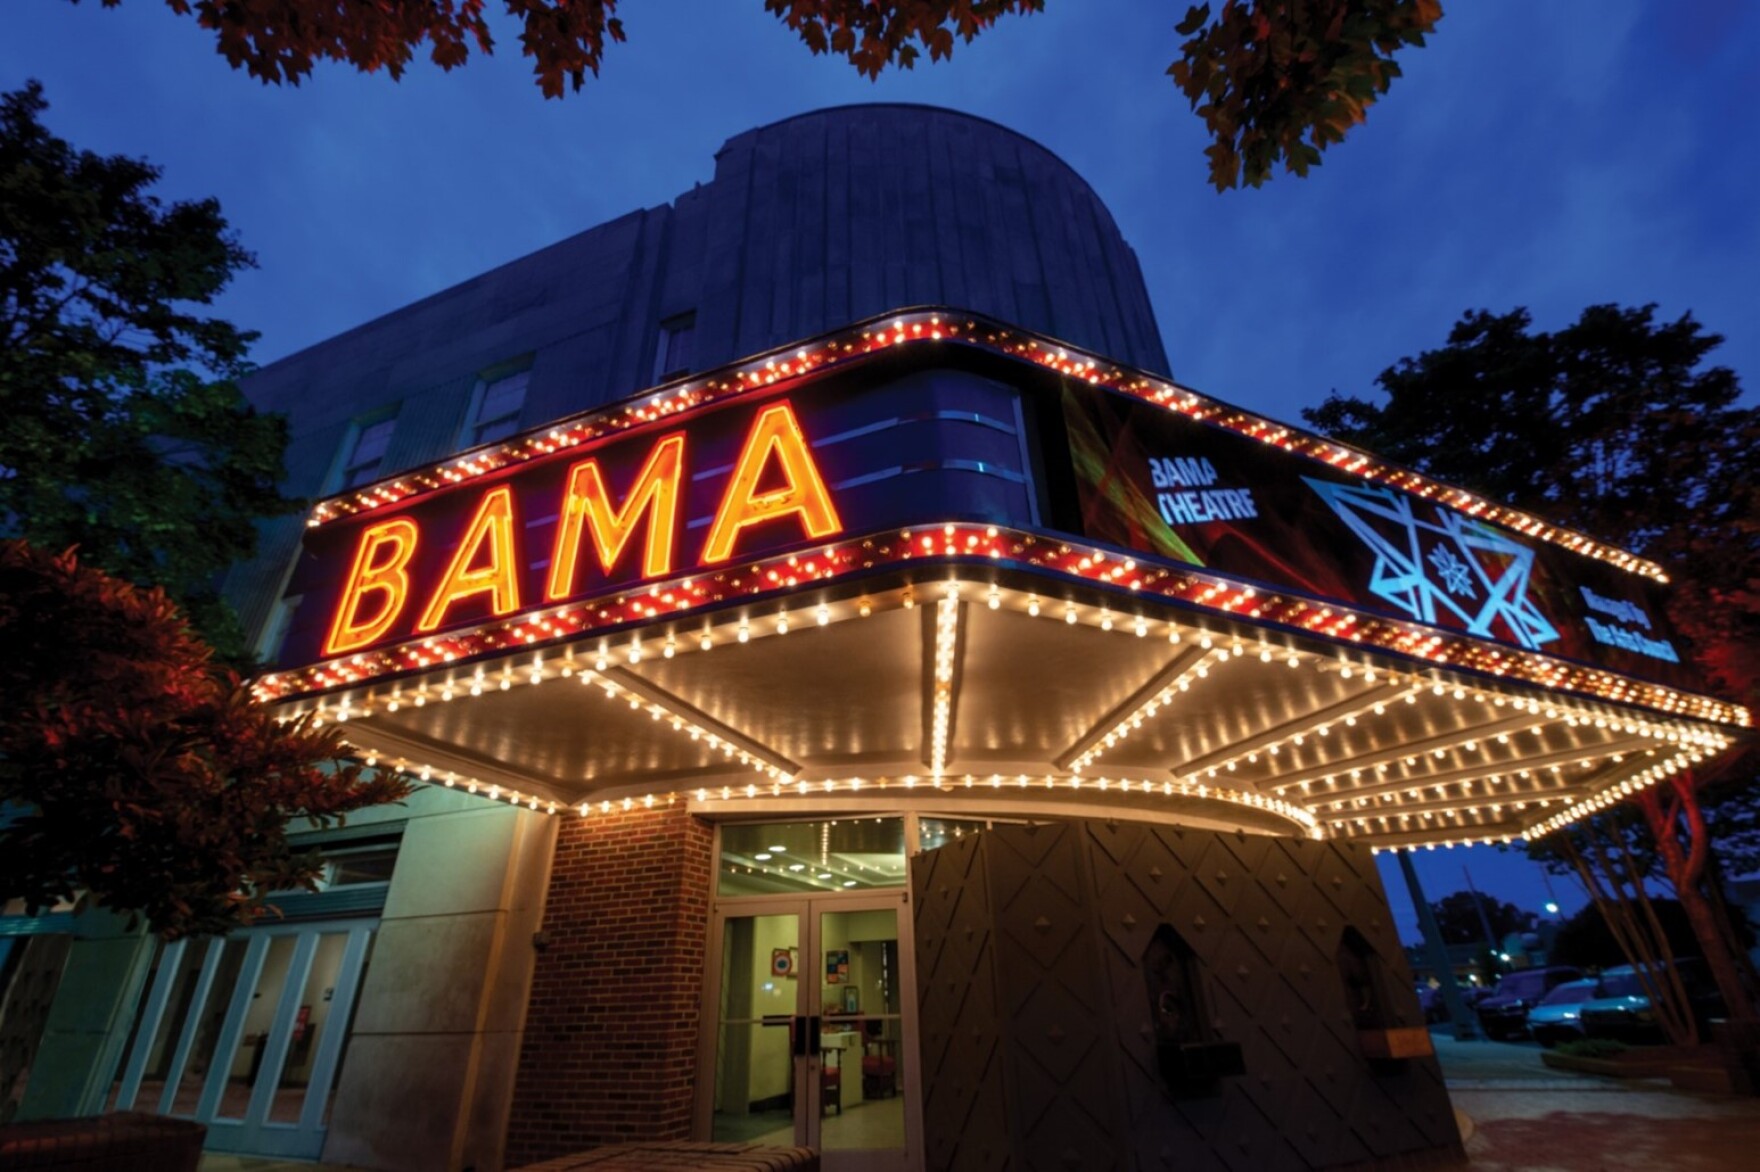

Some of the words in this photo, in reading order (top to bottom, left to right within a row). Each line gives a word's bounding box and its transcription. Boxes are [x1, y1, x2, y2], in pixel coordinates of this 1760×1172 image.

[1149, 456, 1218, 488] BAMA
[1157, 488, 1258, 525] THEATRE
[322, 400, 843, 656] BAMA
